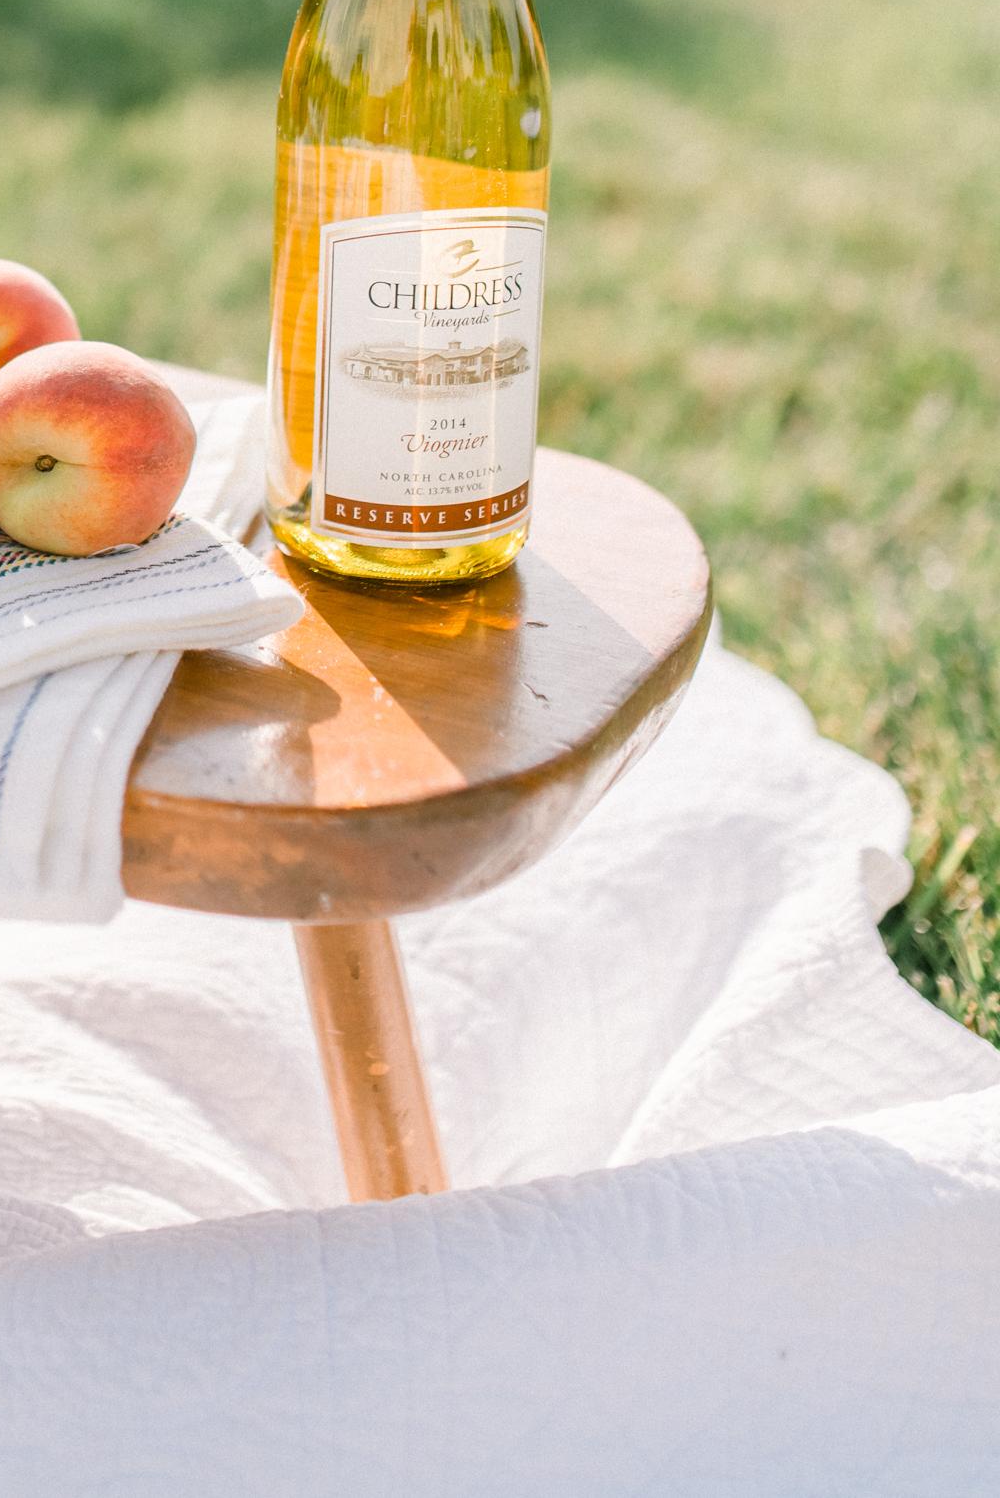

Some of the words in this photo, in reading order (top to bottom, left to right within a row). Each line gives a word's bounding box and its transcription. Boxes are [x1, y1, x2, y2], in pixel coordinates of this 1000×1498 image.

[368, 272, 523, 311] CHILDRESS
[414, 310, 490, 332] Vineyards
[430, 418, 467, 431] 2014
[400, 433, 489, 459] Viognier
[380, 472, 431, 483] NORTH
[438, 465, 503, 482] CAROLINA
[454, 485, 465, 494] BY
[336, 503, 447, 525] RESERVE
[463, 489, 527, 522] SERIES
